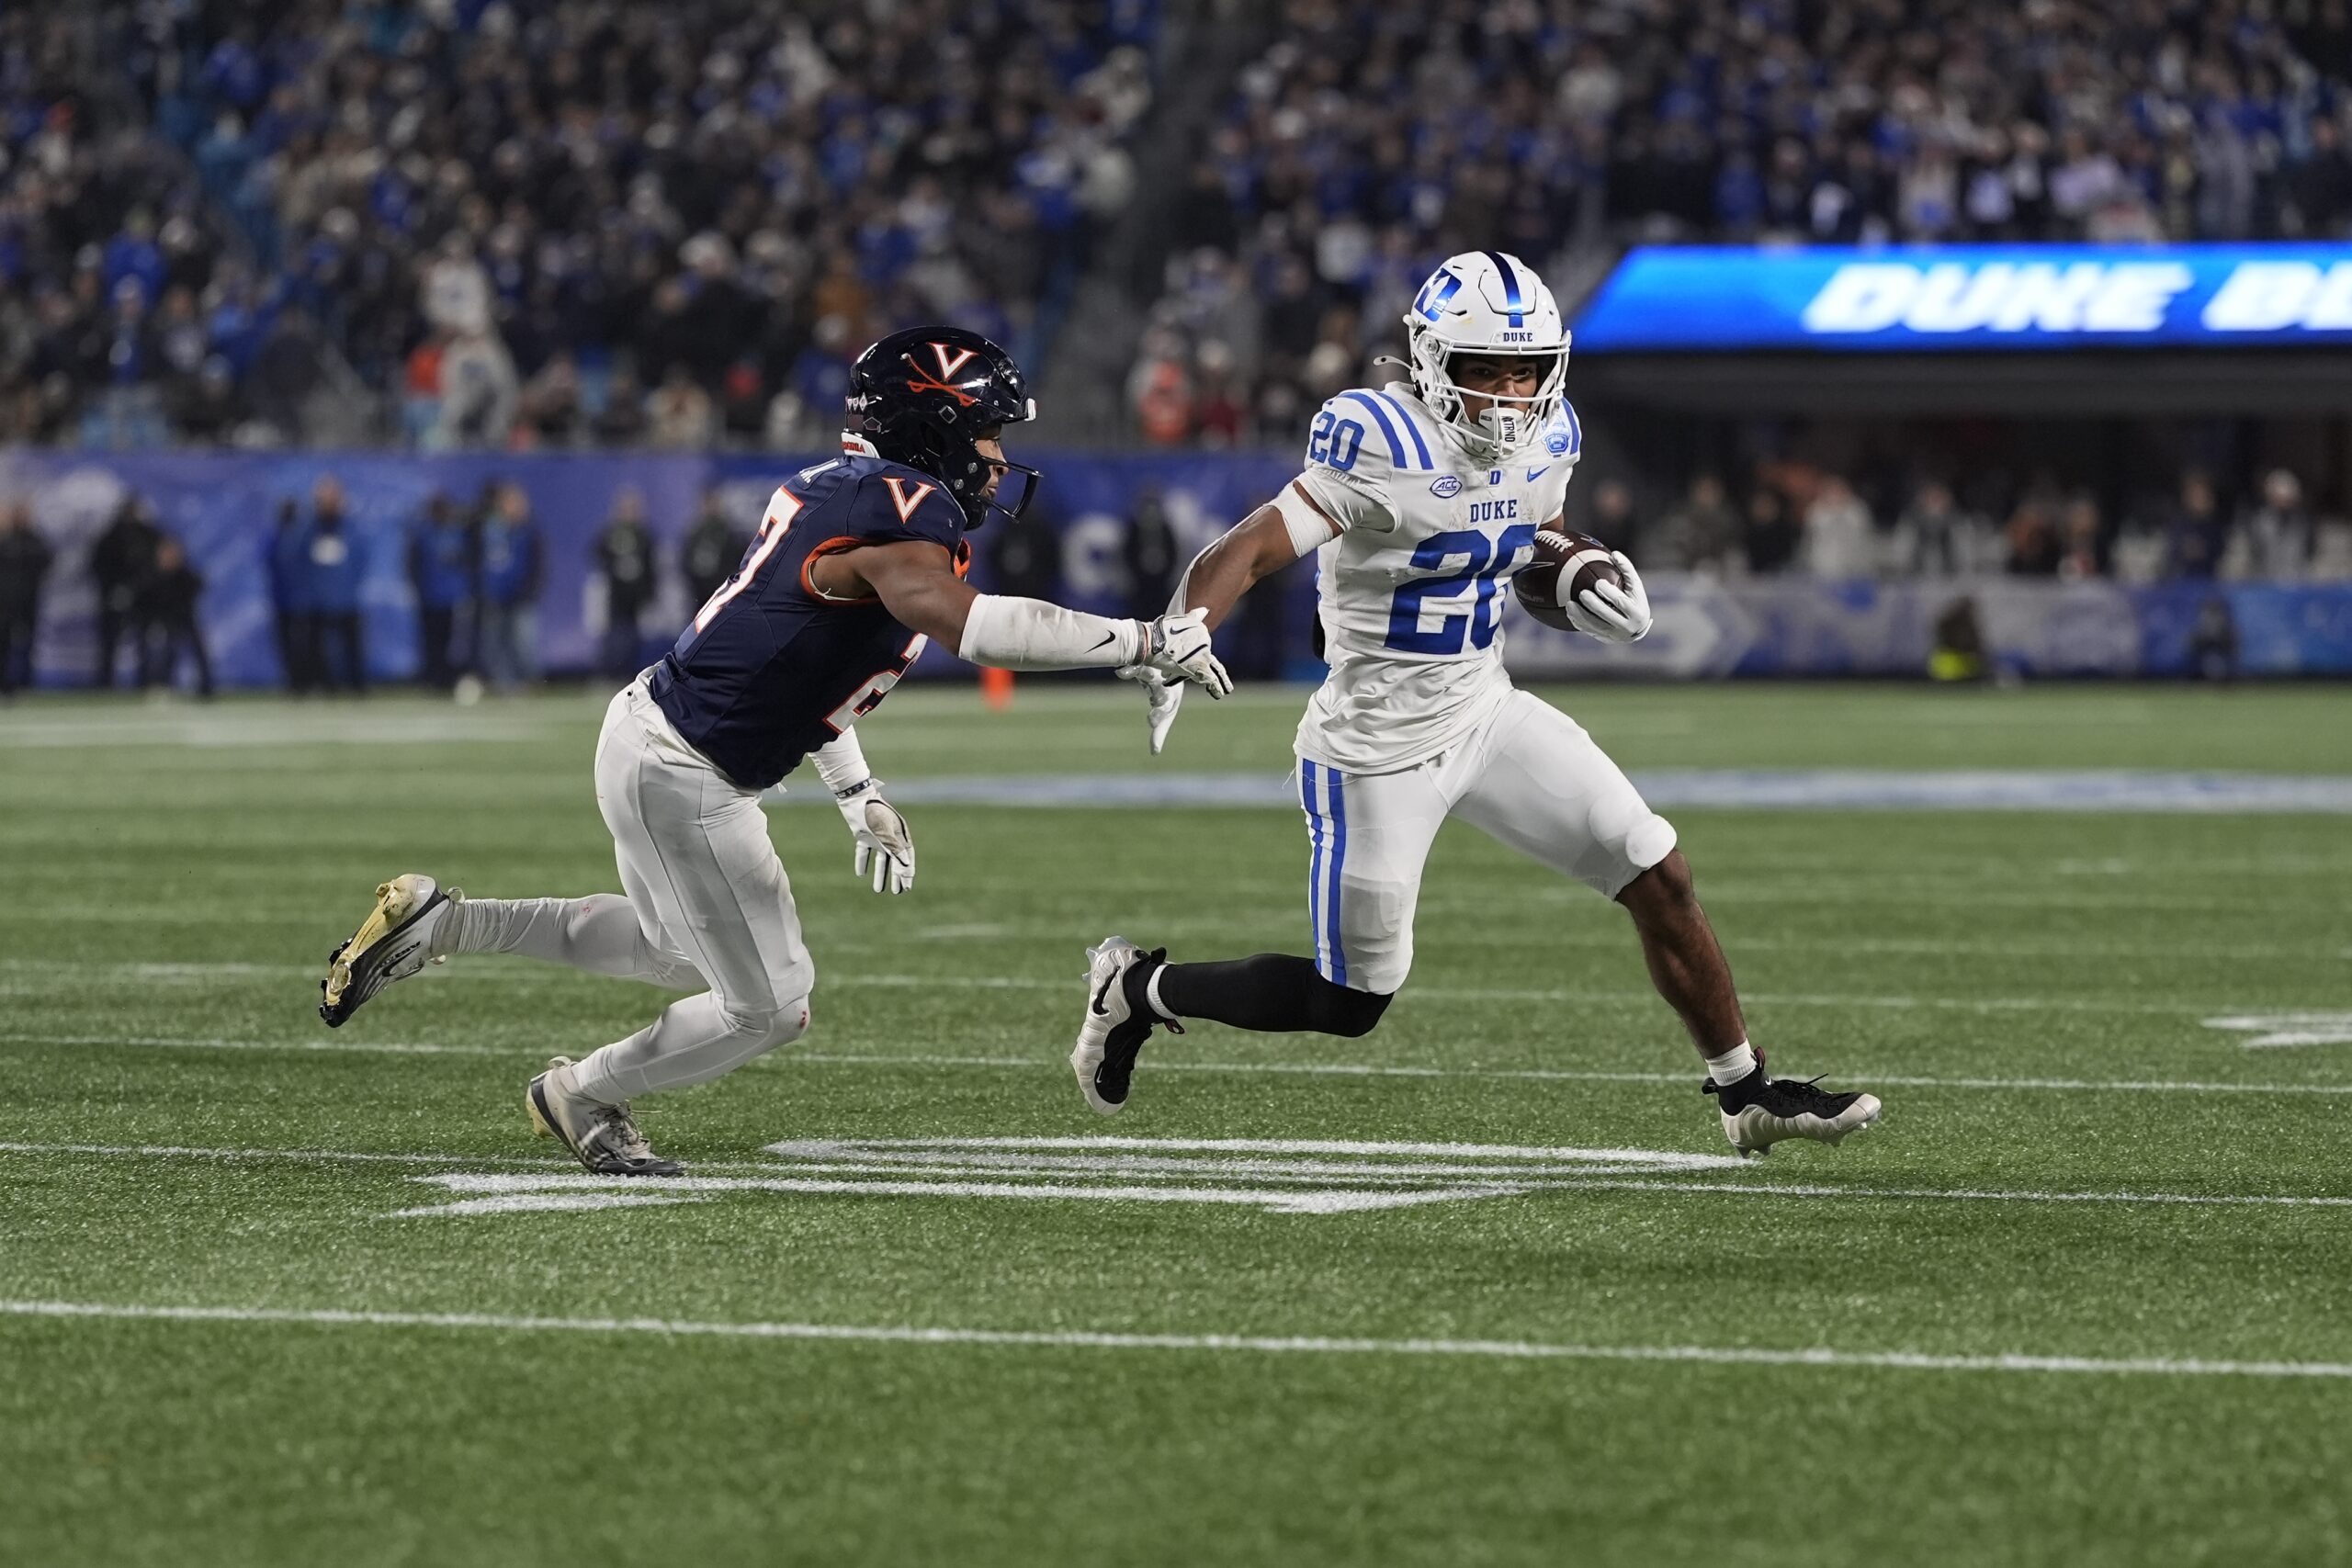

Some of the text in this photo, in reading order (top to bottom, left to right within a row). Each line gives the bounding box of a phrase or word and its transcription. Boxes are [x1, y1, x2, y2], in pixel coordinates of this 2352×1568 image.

[1802, 263, 2196, 332] DUKE
[1503, 333, 1532, 342] DUKE
[927, 343, 978, 382] V
[1309, 412, 1365, 471] 20
[1436, 480, 1457, 491] ACC
[1489, 470, 1500, 485] D
[882, 477, 936, 524] V
[1470, 500, 1517, 523] DUKE
[694, 485, 805, 634] 7
[1385, 524, 1537, 655] 20
